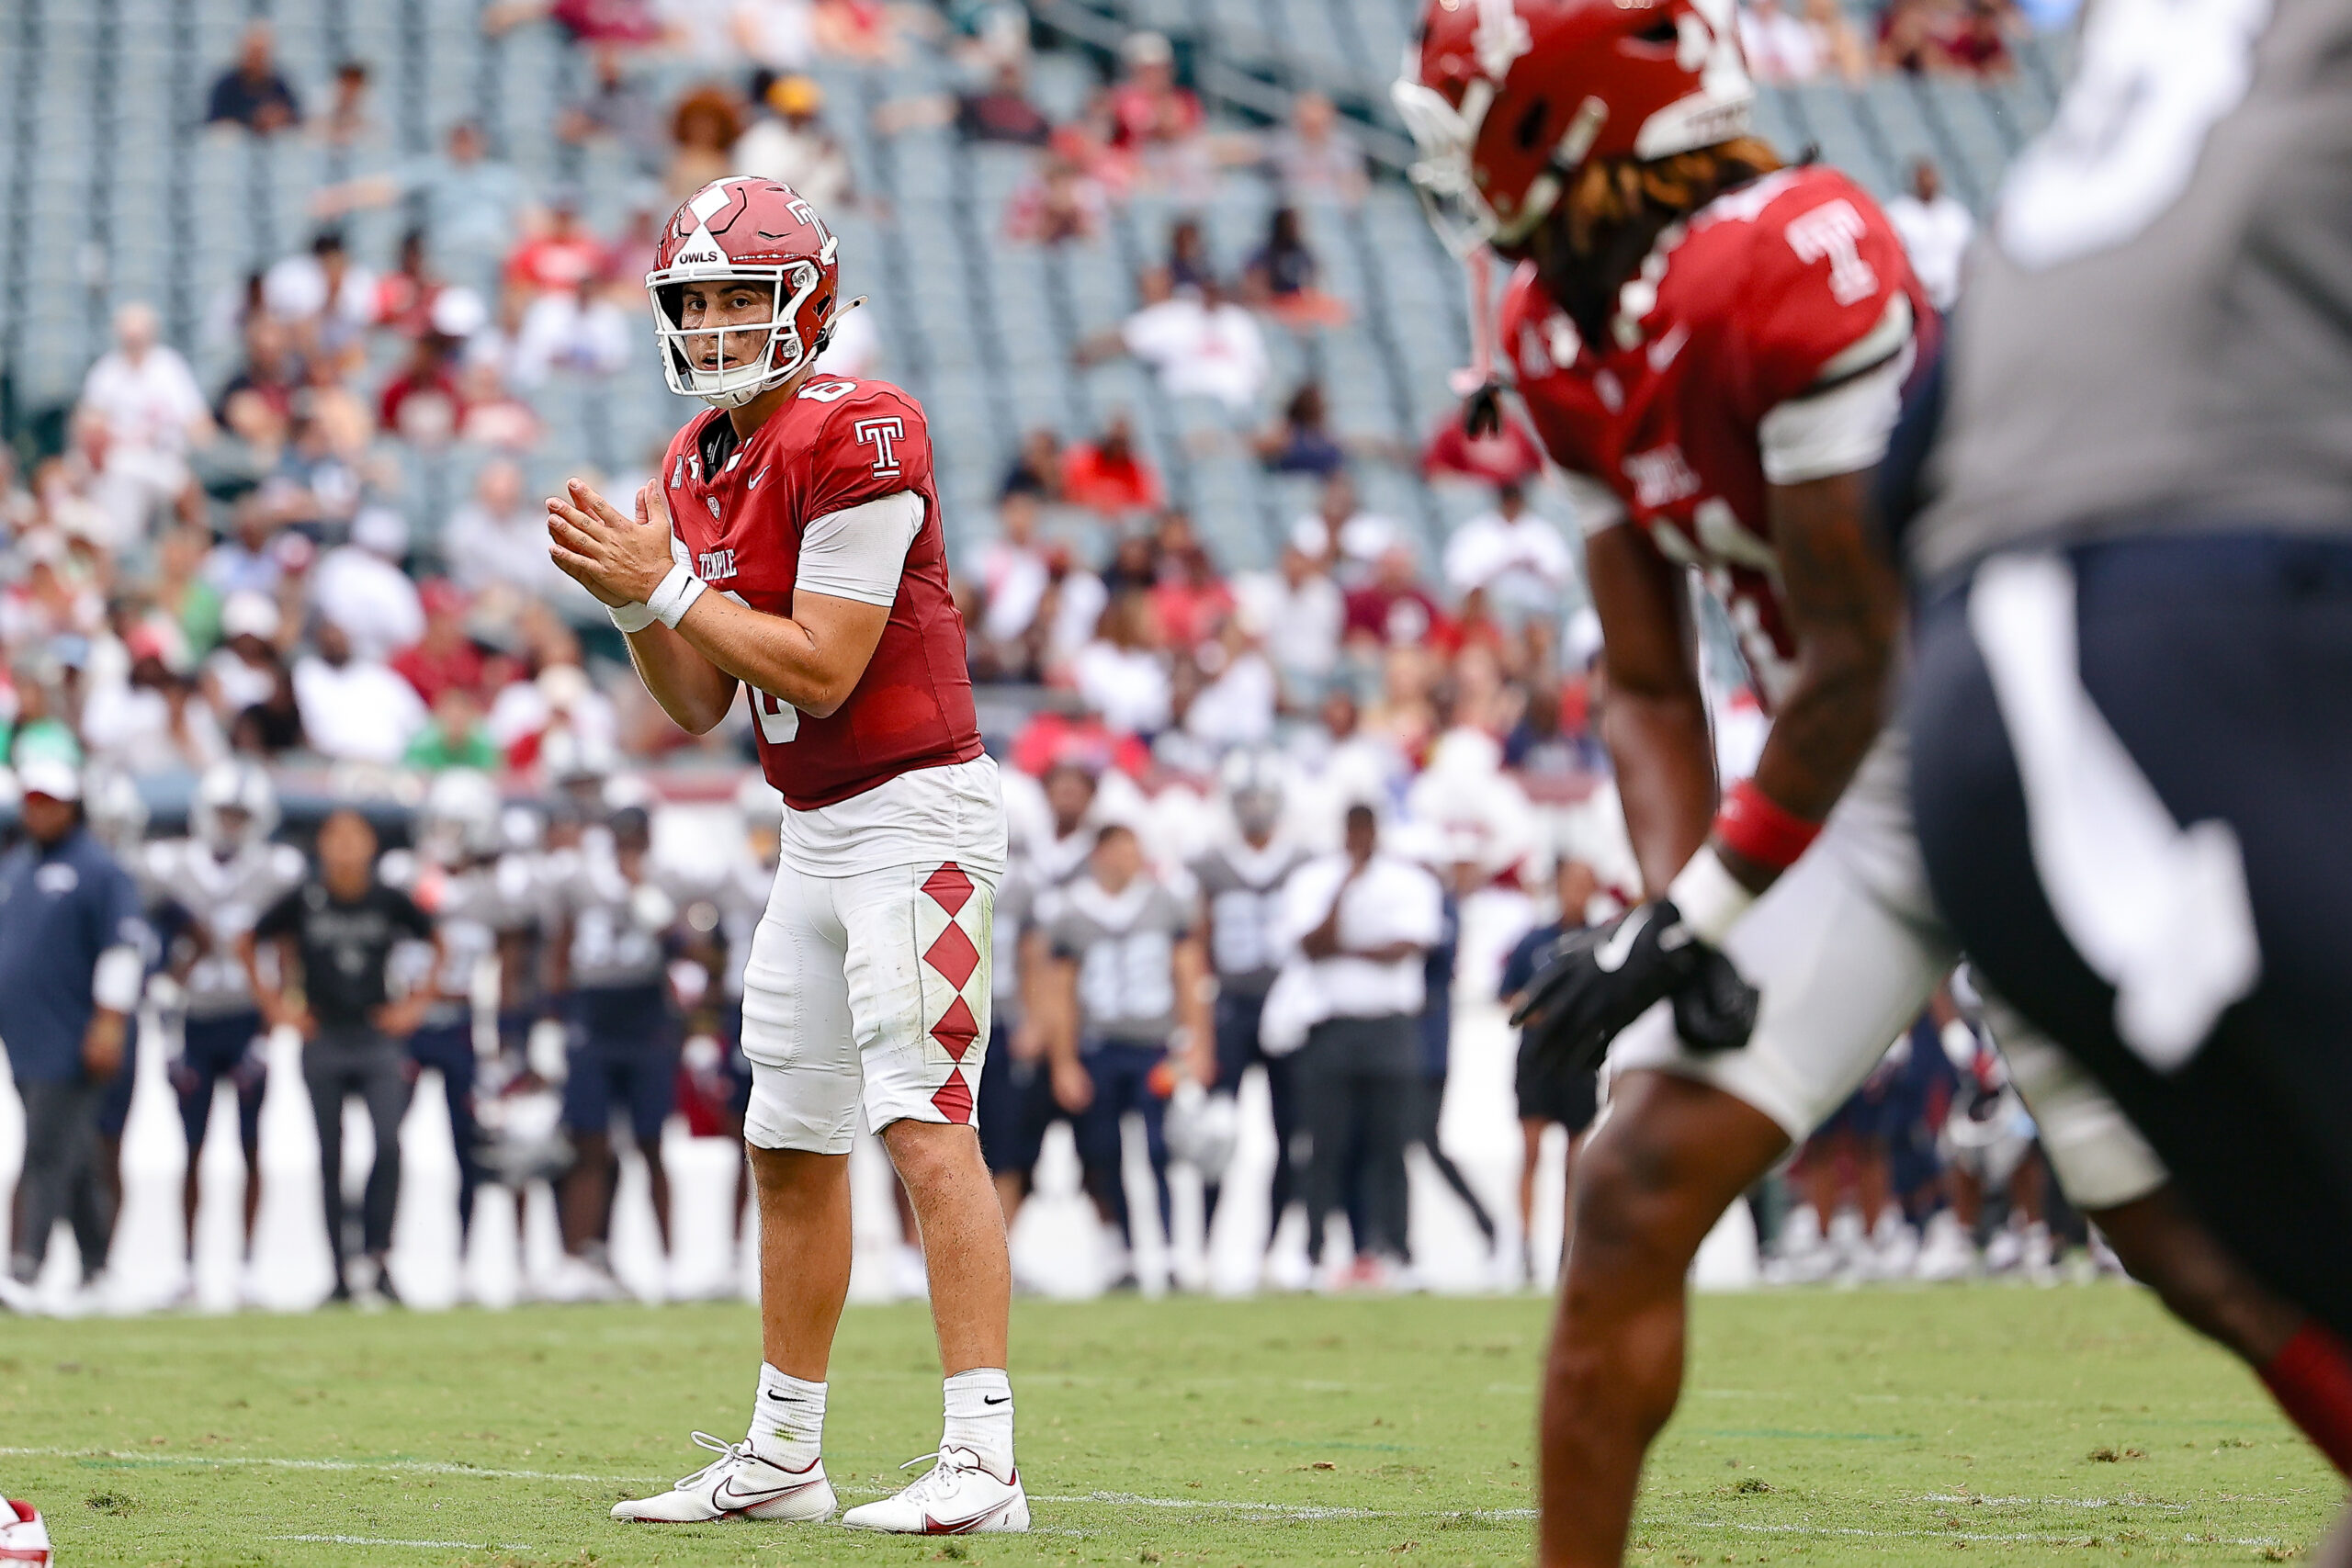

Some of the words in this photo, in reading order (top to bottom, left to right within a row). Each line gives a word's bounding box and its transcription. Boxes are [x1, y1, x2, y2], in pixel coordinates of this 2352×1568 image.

[679, 252, 718, 265] OWLS
[1785, 197, 1879, 307] T
[854, 416, 905, 479] T
[699, 548, 738, 581] TEMPLE
